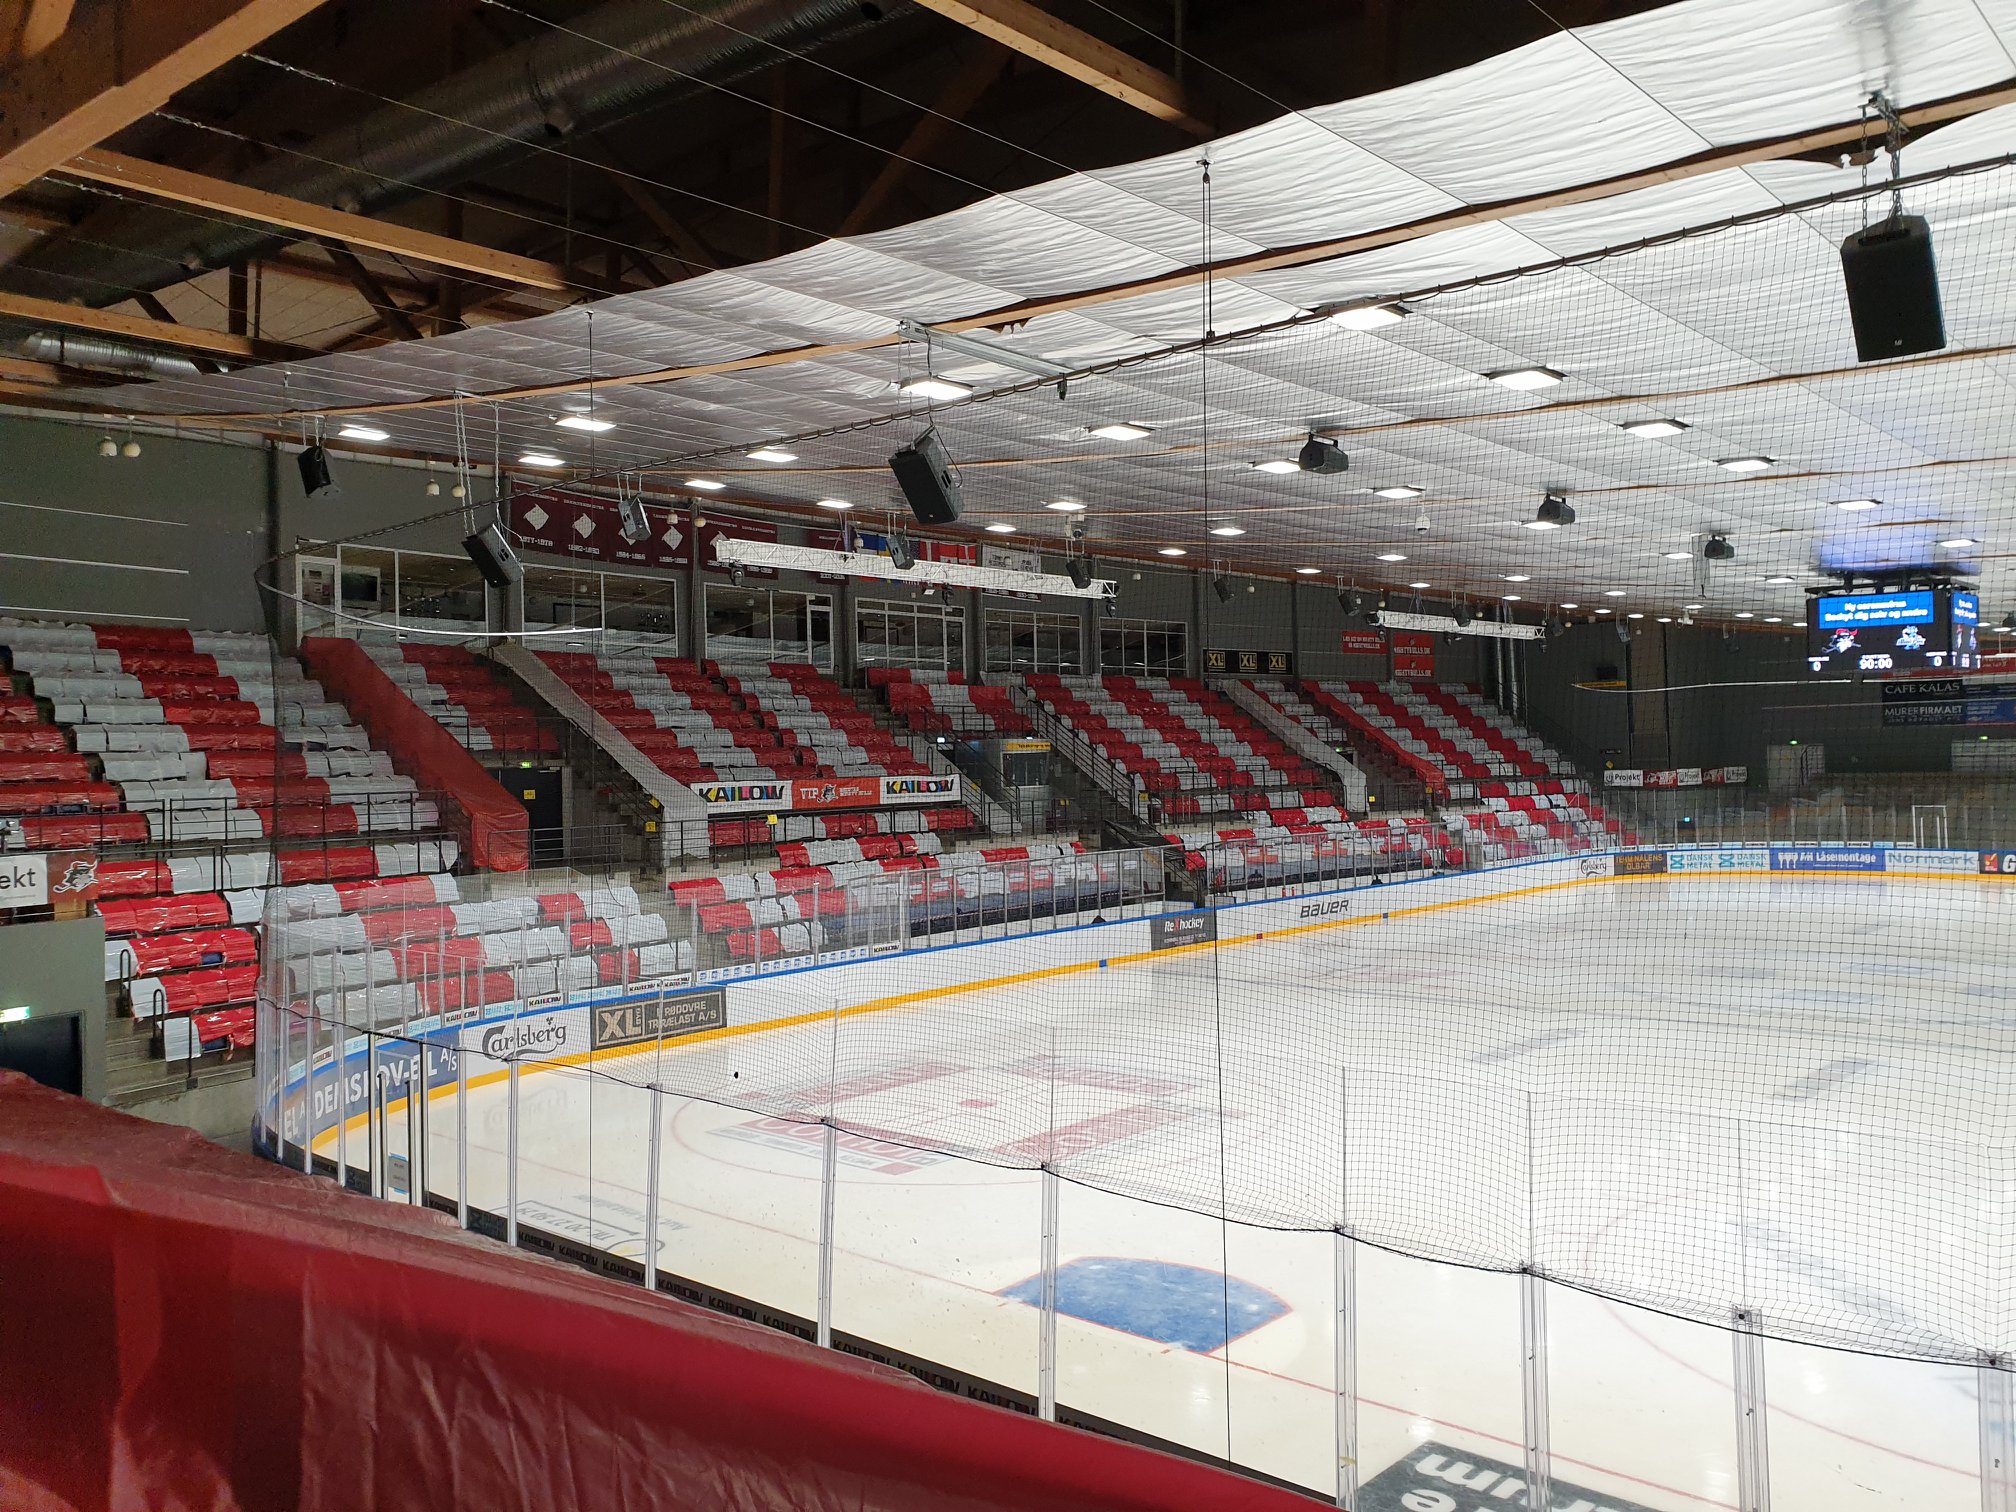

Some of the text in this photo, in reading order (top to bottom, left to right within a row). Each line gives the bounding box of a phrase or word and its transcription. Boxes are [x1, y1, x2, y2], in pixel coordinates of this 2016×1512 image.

[1859, 657, 1893, 670] 90:00
[698, 785, 785, 802] KAILOW
[800, 788, 818, 800] VIP
[886, 778, 954, 795] KAILOW
[482, 1017, 567, 1060] Carlsberg
